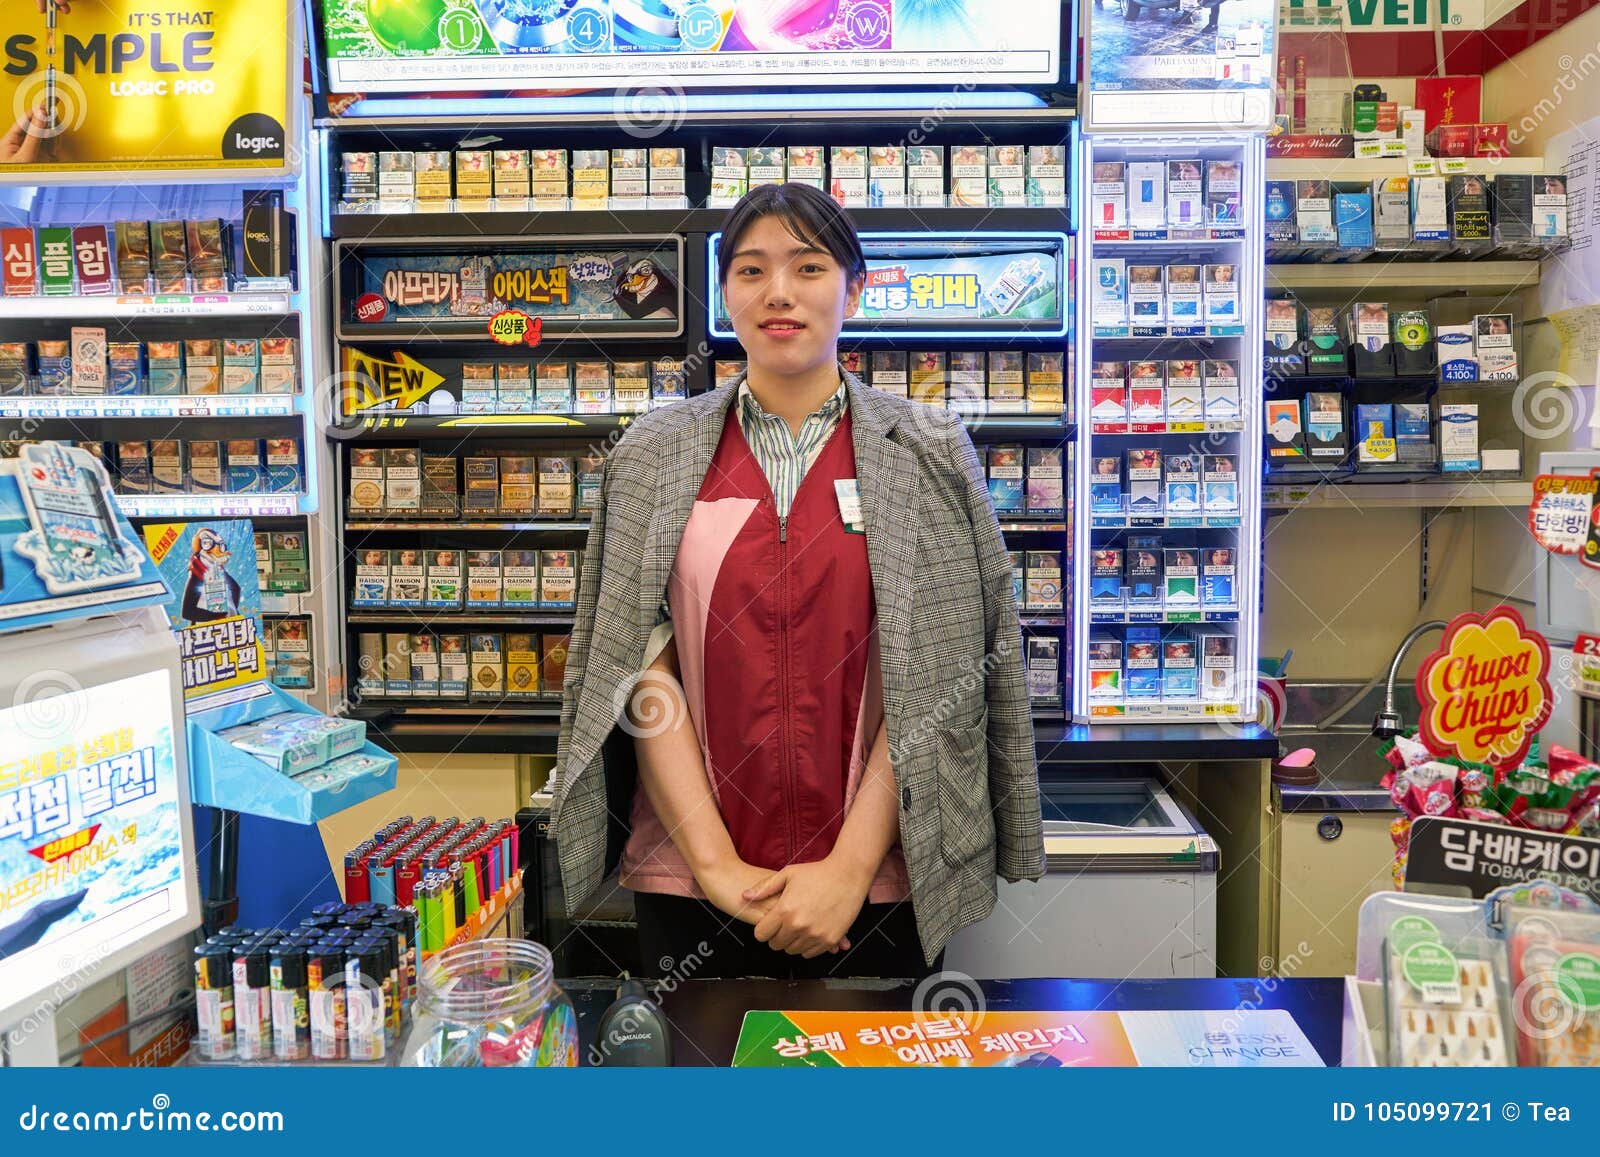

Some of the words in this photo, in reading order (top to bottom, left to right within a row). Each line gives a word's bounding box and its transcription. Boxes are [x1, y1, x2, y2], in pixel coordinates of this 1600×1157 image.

[129, 13, 161, 26] IT'S
[167, 11, 214, 26] THAT
[579, 17, 593, 41] 4
[688, 19, 713, 35] UP
[110, 82, 167, 96] LOGIC
[174, 80, 215, 95] PRO
[236, 133, 280, 153] logic.
[1308, 136, 1345, 149] World
[4, 243, 33, 277] 심
[41, 242, 71, 277] 플
[76, 240, 107, 276] 함
[384, 270, 459, 305] 아프리카
[493, 266, 570, 305] 아이스잭
[871, 271, 900, 284] 신제품
[357, 301, 385, 319] 신제품
[493, 318, 525, 335] 신상품
[354, 358, 425, 404] NEW
[618, 390, 644, 400] AFRICA
[1441, 650, 1532, 693] Chupa
[1439, 685, 1531, 738] Chups
[78, 745, 157, 819] 발견!
[1478, 860, 1562, 886] TOBACCO
[771, 1030, 849, 1058] 상쾌
[856, 1016, 973, 1047] 히어로!
[896, 1038, 974, 1065] 에쎄
[979, 1024, 1090, 1054] 체인지
